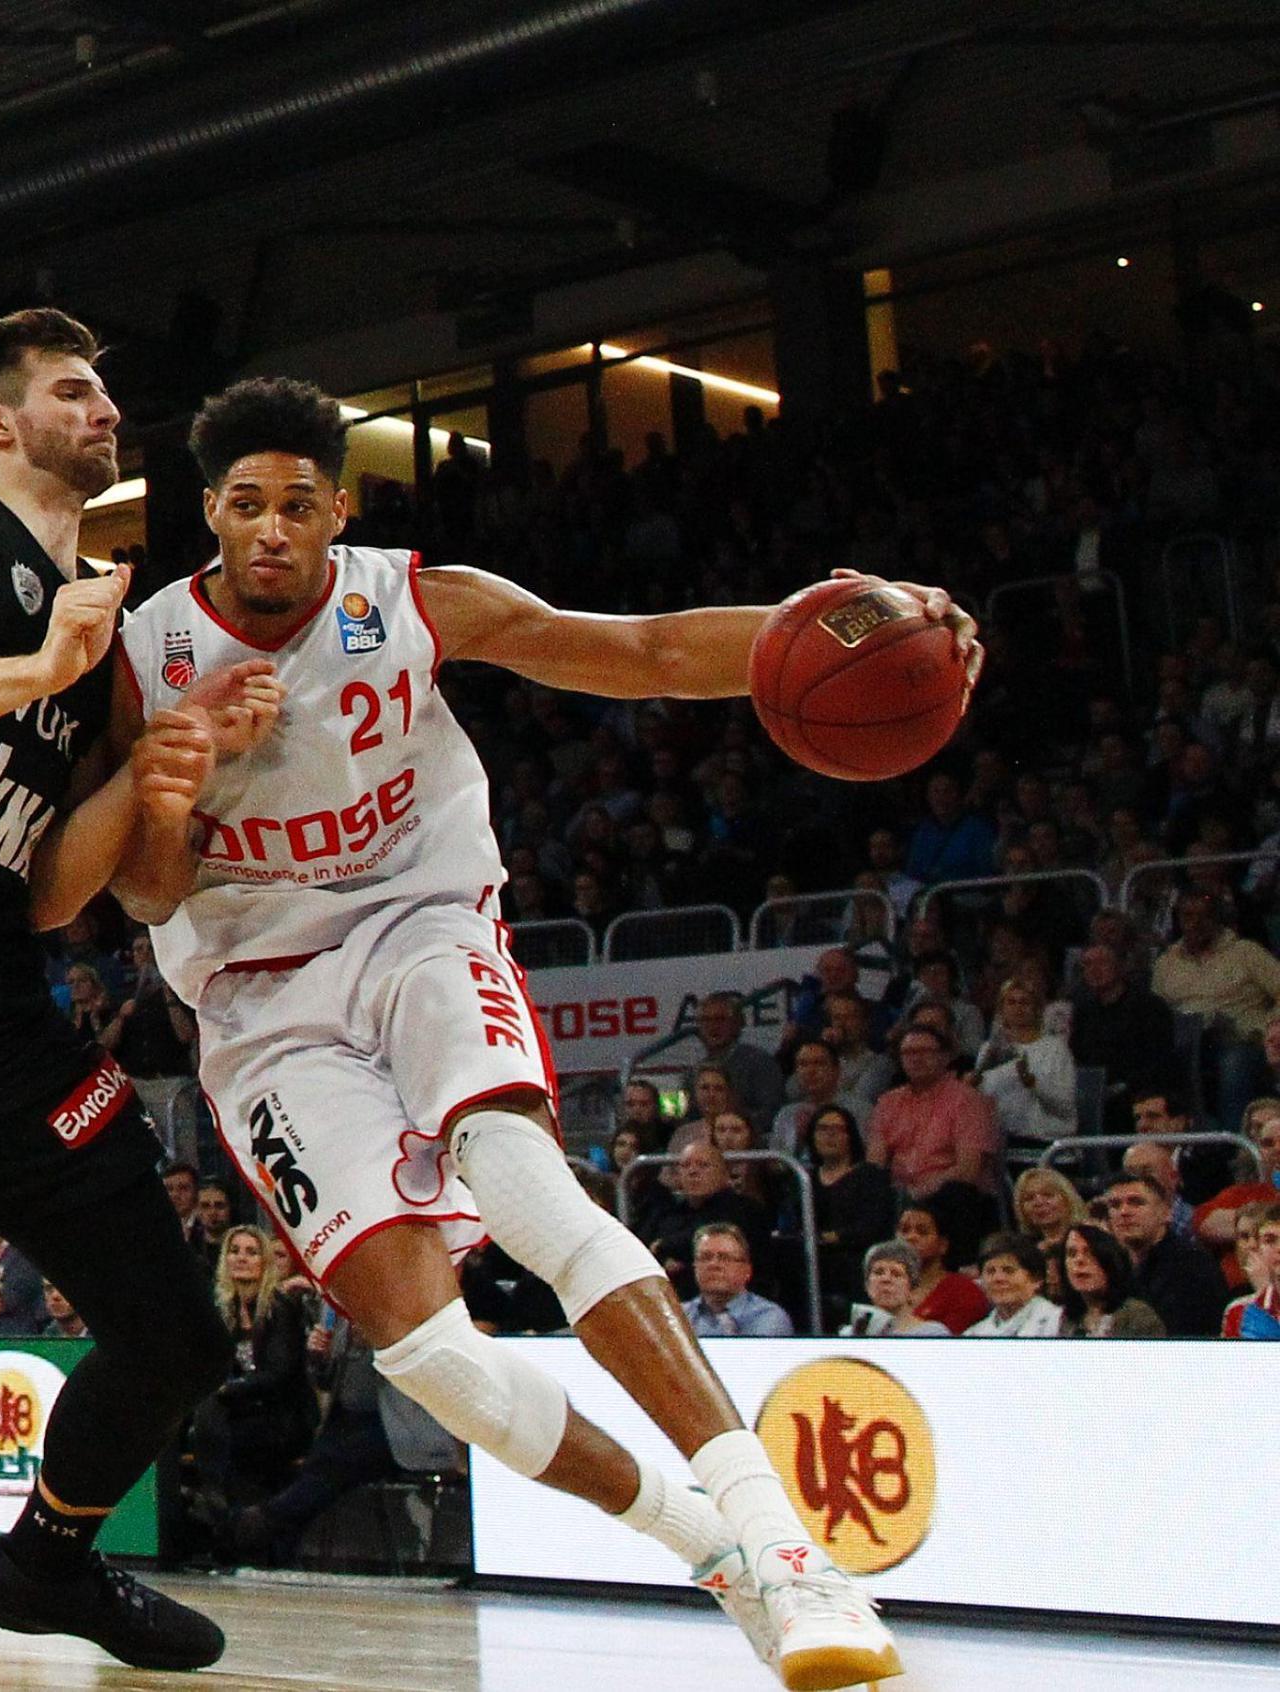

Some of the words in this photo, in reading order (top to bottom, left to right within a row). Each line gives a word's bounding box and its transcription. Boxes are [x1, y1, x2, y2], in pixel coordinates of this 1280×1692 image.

[340, 668, 412, 756] 21
[334, 814, 423, 878] Mechatronics
[457, 944, 528, 1057] EWE
